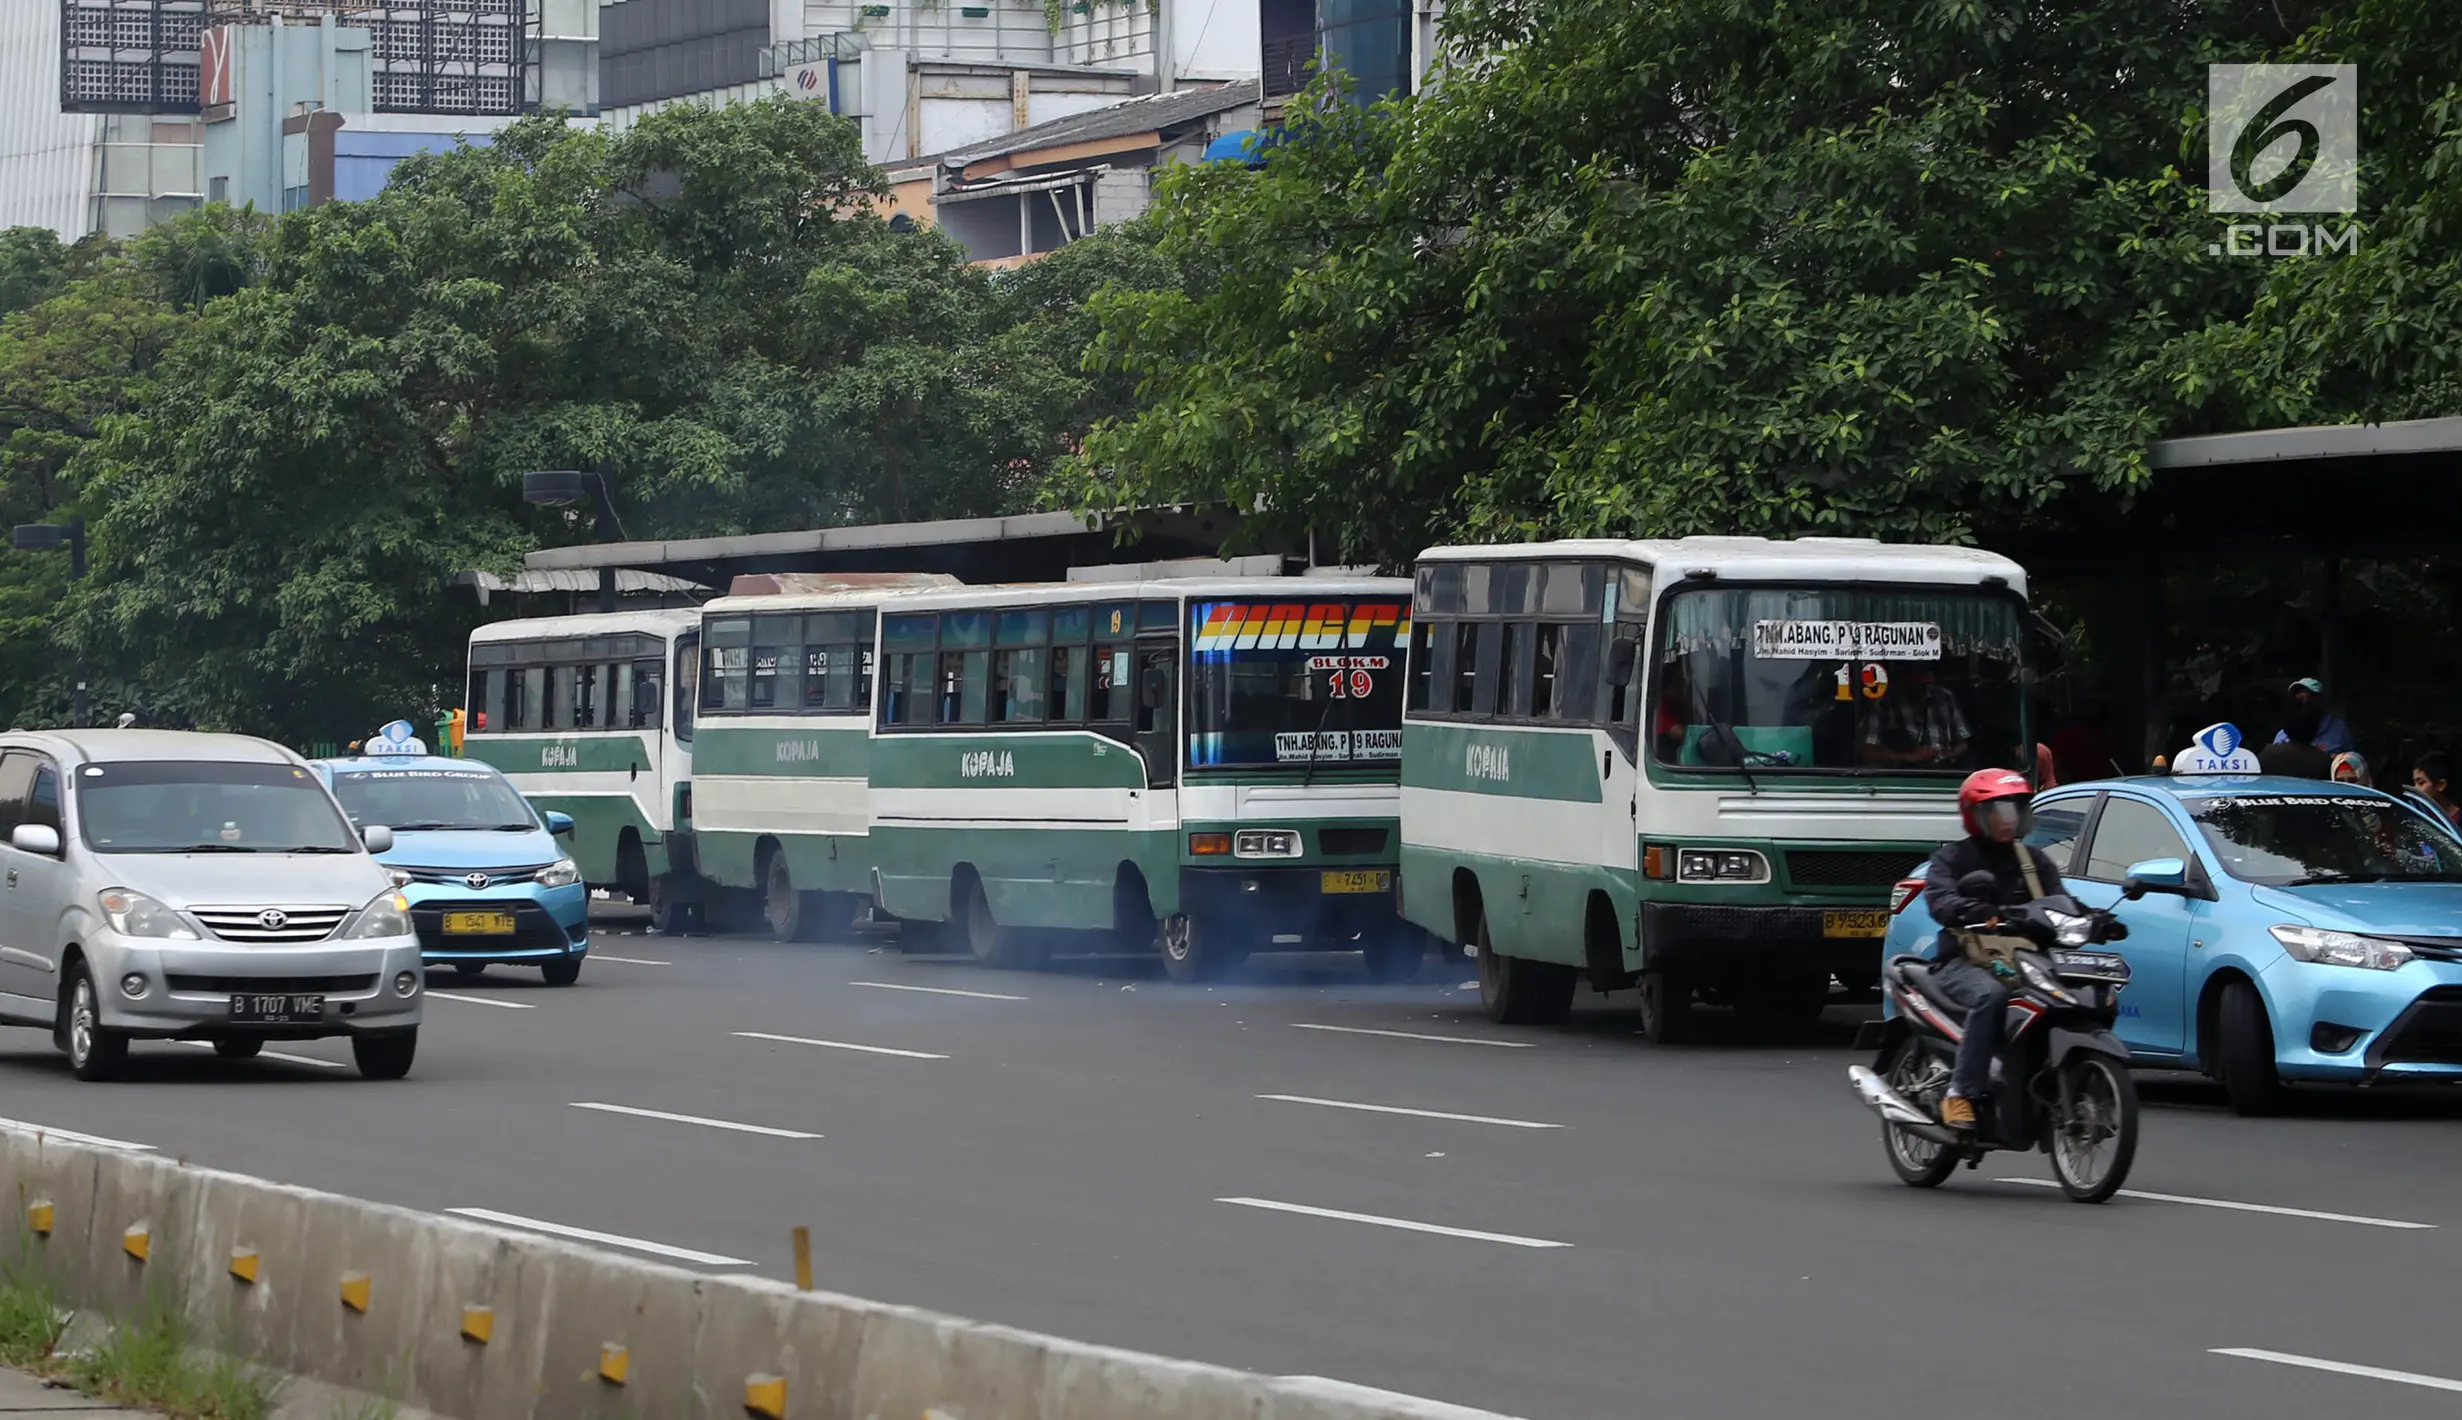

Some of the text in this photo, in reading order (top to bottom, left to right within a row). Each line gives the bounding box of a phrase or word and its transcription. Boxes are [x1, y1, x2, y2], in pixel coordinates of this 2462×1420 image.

[1111, 610, 1121, 633] 19
[1865, 626, 1924, 645] RAGUNAN
[1330, 670, 1372, 698] 19
[1834, 662, 1888, 701] 19
[377, 744, 417, 753] TAKSI
[541, 746, 577, 767] KOPAJA
[776, 740, 819, 762] KOPAJA
[961, 750, 1014, 778] KOPAJA
[2196, 759, 2248, 770] TAKSI
[234, 996, 245, 1013] B
[252, 996, 287, 1013] 1707
